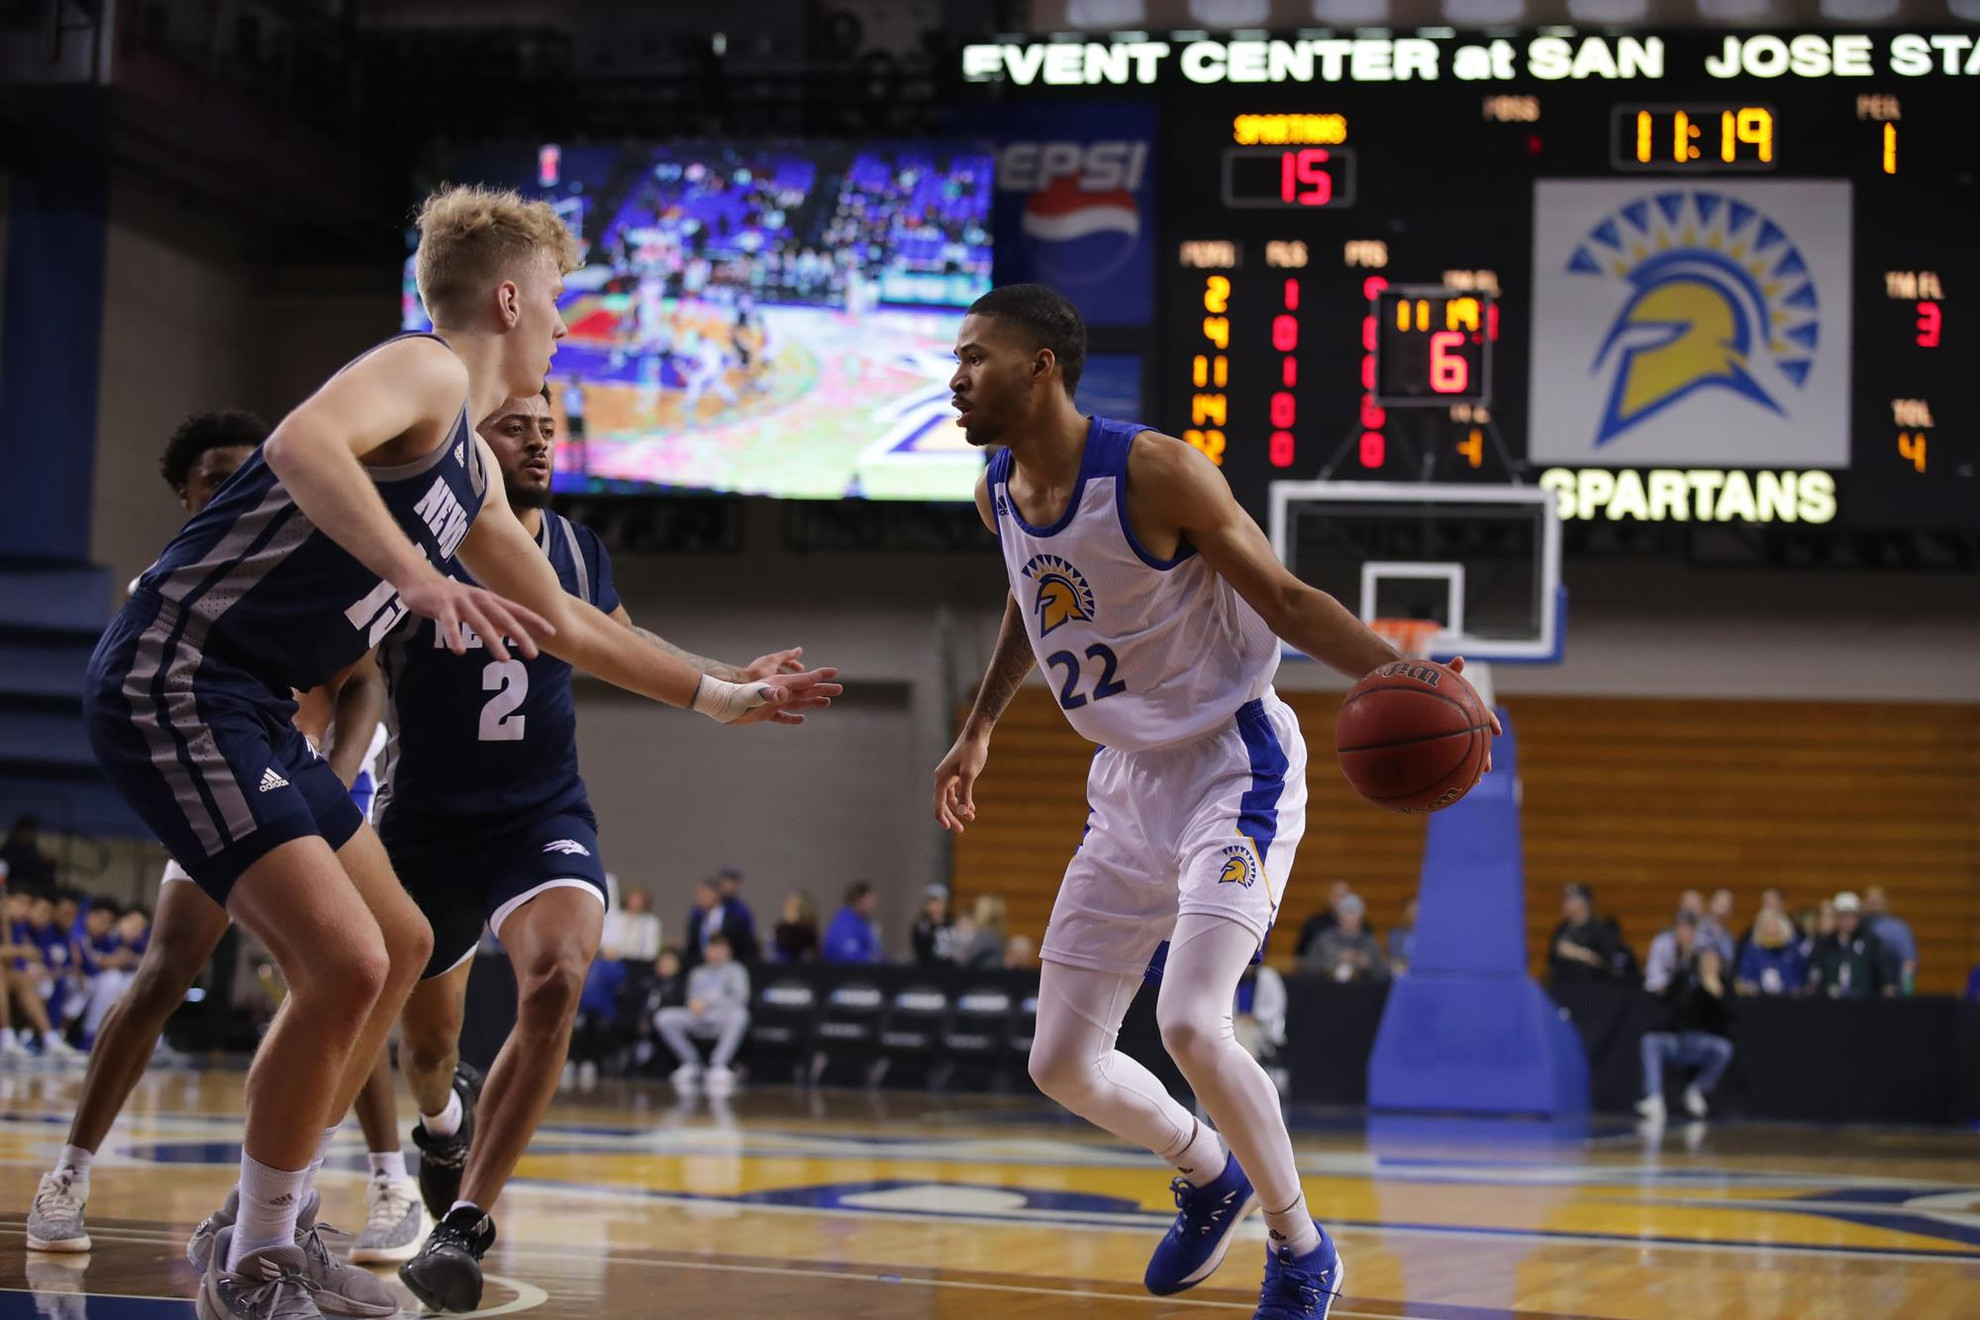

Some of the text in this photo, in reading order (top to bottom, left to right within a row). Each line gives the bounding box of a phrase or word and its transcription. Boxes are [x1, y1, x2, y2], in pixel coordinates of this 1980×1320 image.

[963, 43, 1170, 85] EVENT
[1180, 39, 1439, 83] CENTER
[1453, 40, 1516, 80] at
[1527, 36, 1665, 80] SAN
[1705, 35, 1874, 78] JOSE
[1636, 107, 1774, 163] 11:19
[1883, 121, 1897, 175] 1
[998, 142, 1148, 190] EPSI
[1281, 148, 1332, 206] 15
[1284, 278, 1300, 311] 1
[1916, 301, 1942, 348] 3
[1282, 355, 1298, 388] 1
[1429, 330, 1468, 394] 6
[1898, 433, 1927, 472] 4
[1539, 467, 1837, 524] SPARTANS
[478, 659, 529, 741] 2
[1046, 643, 1127, 710] 22
